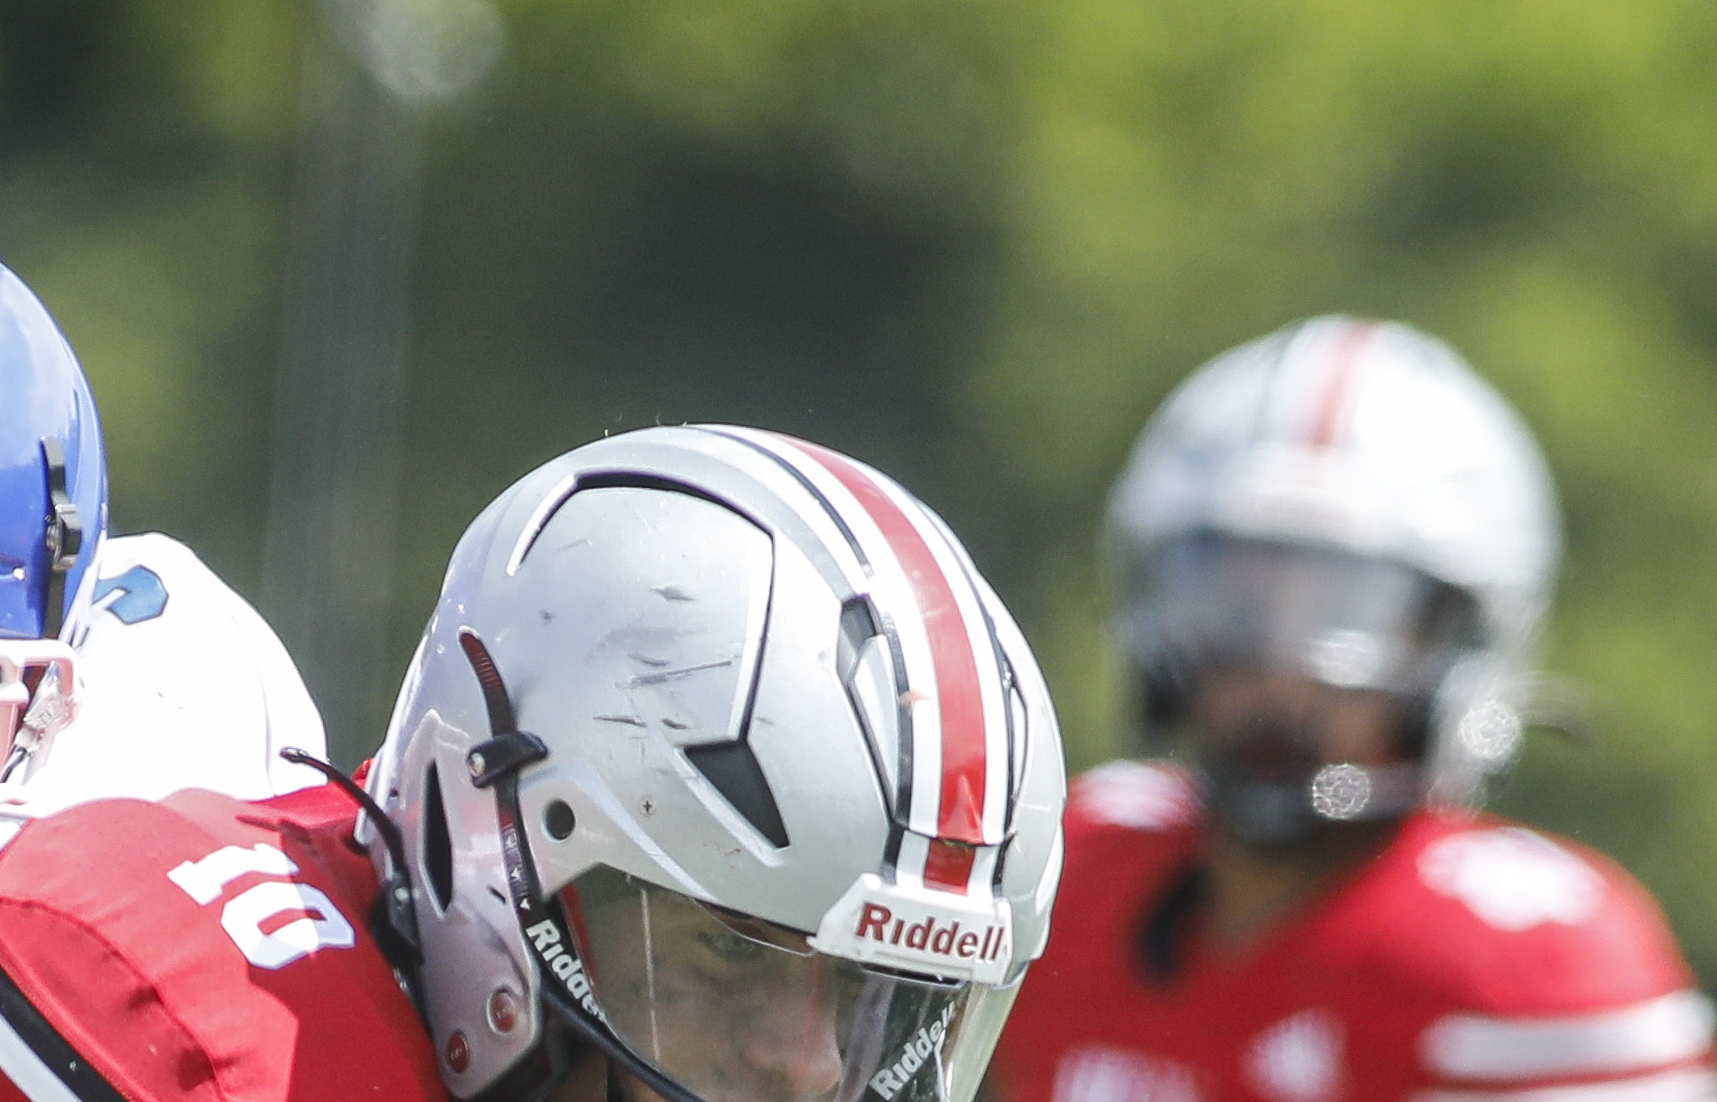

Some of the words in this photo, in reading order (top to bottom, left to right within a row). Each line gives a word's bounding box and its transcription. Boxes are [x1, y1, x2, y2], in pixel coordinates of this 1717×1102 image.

[166, 842, 356, 971] 10
[856, 902, 1004, 961] Riddell
[868, 1000, 956, 1101] Riddell
